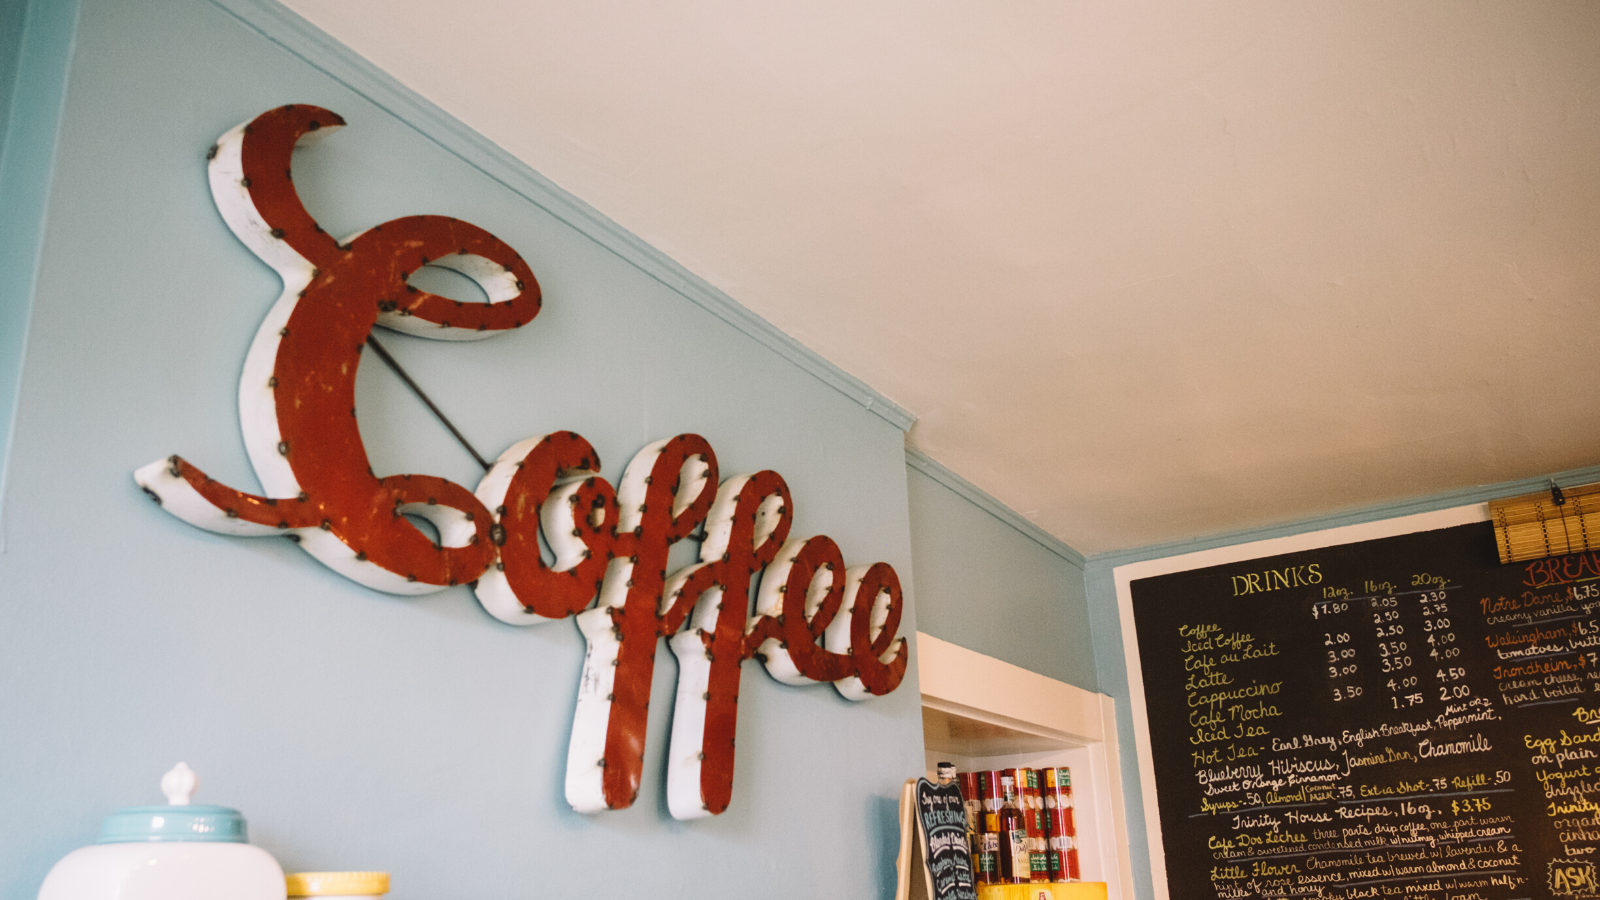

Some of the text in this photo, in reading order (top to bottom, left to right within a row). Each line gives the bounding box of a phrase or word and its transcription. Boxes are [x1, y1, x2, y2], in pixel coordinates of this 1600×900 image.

[134, 103, 908, 820] Coffee
[1231, 563, 1323, 597] DRINKS
[1178, 591, 1447, 640] Coffee $1.80 2.05 2.30
[1480, 596, 1521, 615] Notre
[1487, 612, 1532, 625] creamy
[1533, 604, 1579, 617] vanilla
[1181, 603, 1449, 653] Iced Coffee 2.50 2.75
[1568, 634, 1600, 650] butt
[1184, 617, 1451, 675] Cafe au Lait 2.00 2.50 3.00
[1185, 632, 1456, 690] Latte 3.00 3.50 4.00
[1187, 647, 1460, 709] Cappuccino 3.00 3.50 4.00
[1499, 679, 1542, 692] cream
[1189, 667, 1466, 731] Cafe Mocha 3.50 4.00 4.50
[1189, 684, 1470, 745] Iced Tea 1.75 2.00
[1191, 747, 1223, 768] Hot
[1272, 737, 1302, 752] Earl
[1342, 729, 1380, 747] English
[1195, 763, 1264, 785] Blueberry
[1341, 749, 1388, 777] Jasmine
[1418, 732, 1493, 758] Chamomile
[1524, 735, 1557, 754] Egg
[1532, 748, 1598, 769] on plain
[1204, 773, 1342, 796] Sweet Orange Cinnamon
[1305, 782, 1337, 793] Coconut
[1536, 764, 1592, 791] Yogurt
[923, 809, 966, 830] REFRESHING
[1232, 813, 1281, 833] Trinity
[1284, 810, 1333, 824] House
[1451, 797, 1492, 816] $3.75
[1208, 835, 1236, 857] Cafe
[1236, 833, 1264, 847] Dos
[1265, 830, 1309, 844] Leches
[1312, 828, 1339, 840] three
[1342, 824, 1373, 847] parts
[1374, 823, 1398, 836] drip
[1430, 820, 1450, 830] one
[1453, 816, 1478, 832] part
[1480, 815, 1515, 825] warm
[1308, 838, 1363, 850] condensed
[1364, 836, 1389, 847] milk
[1439, 829, 1477, 844] whipped
[1477, 826, 1511, 837] cream
[1565, 844, 1597, 856] two
[1210, 866, 1248, 881] Little
[1252, 861, 1301, 876] Flower
[1306, 854, 1364, 869] Chamomile
[1365, 852, 1386, 864] tea
[1387, 850, 1429, 863] brewed
[1445, 844, 1496, 858] lavender
[1497, 840, 1508, 853] &
[1511, 843, 1523, 852] a
[1246, 878, 1262, 894] of
[1265, 878, 1295, 888] rose
[1349, 866, 1382, 879] mixed
[1426, 860, 1468, 873] almond
[1468, 858, 1476, 870] &
[1477, 854, 1521, 868] coconut
[1261, 885, 1287, 896] and
[1289, 885, 1325, 898] honey
[1346, 886, 1380, 899] black
[1381, 886, 1403, 895] tea
[1405, 881, 1443, 893] mixed
[1555, 865, 1596, 895] ASK
